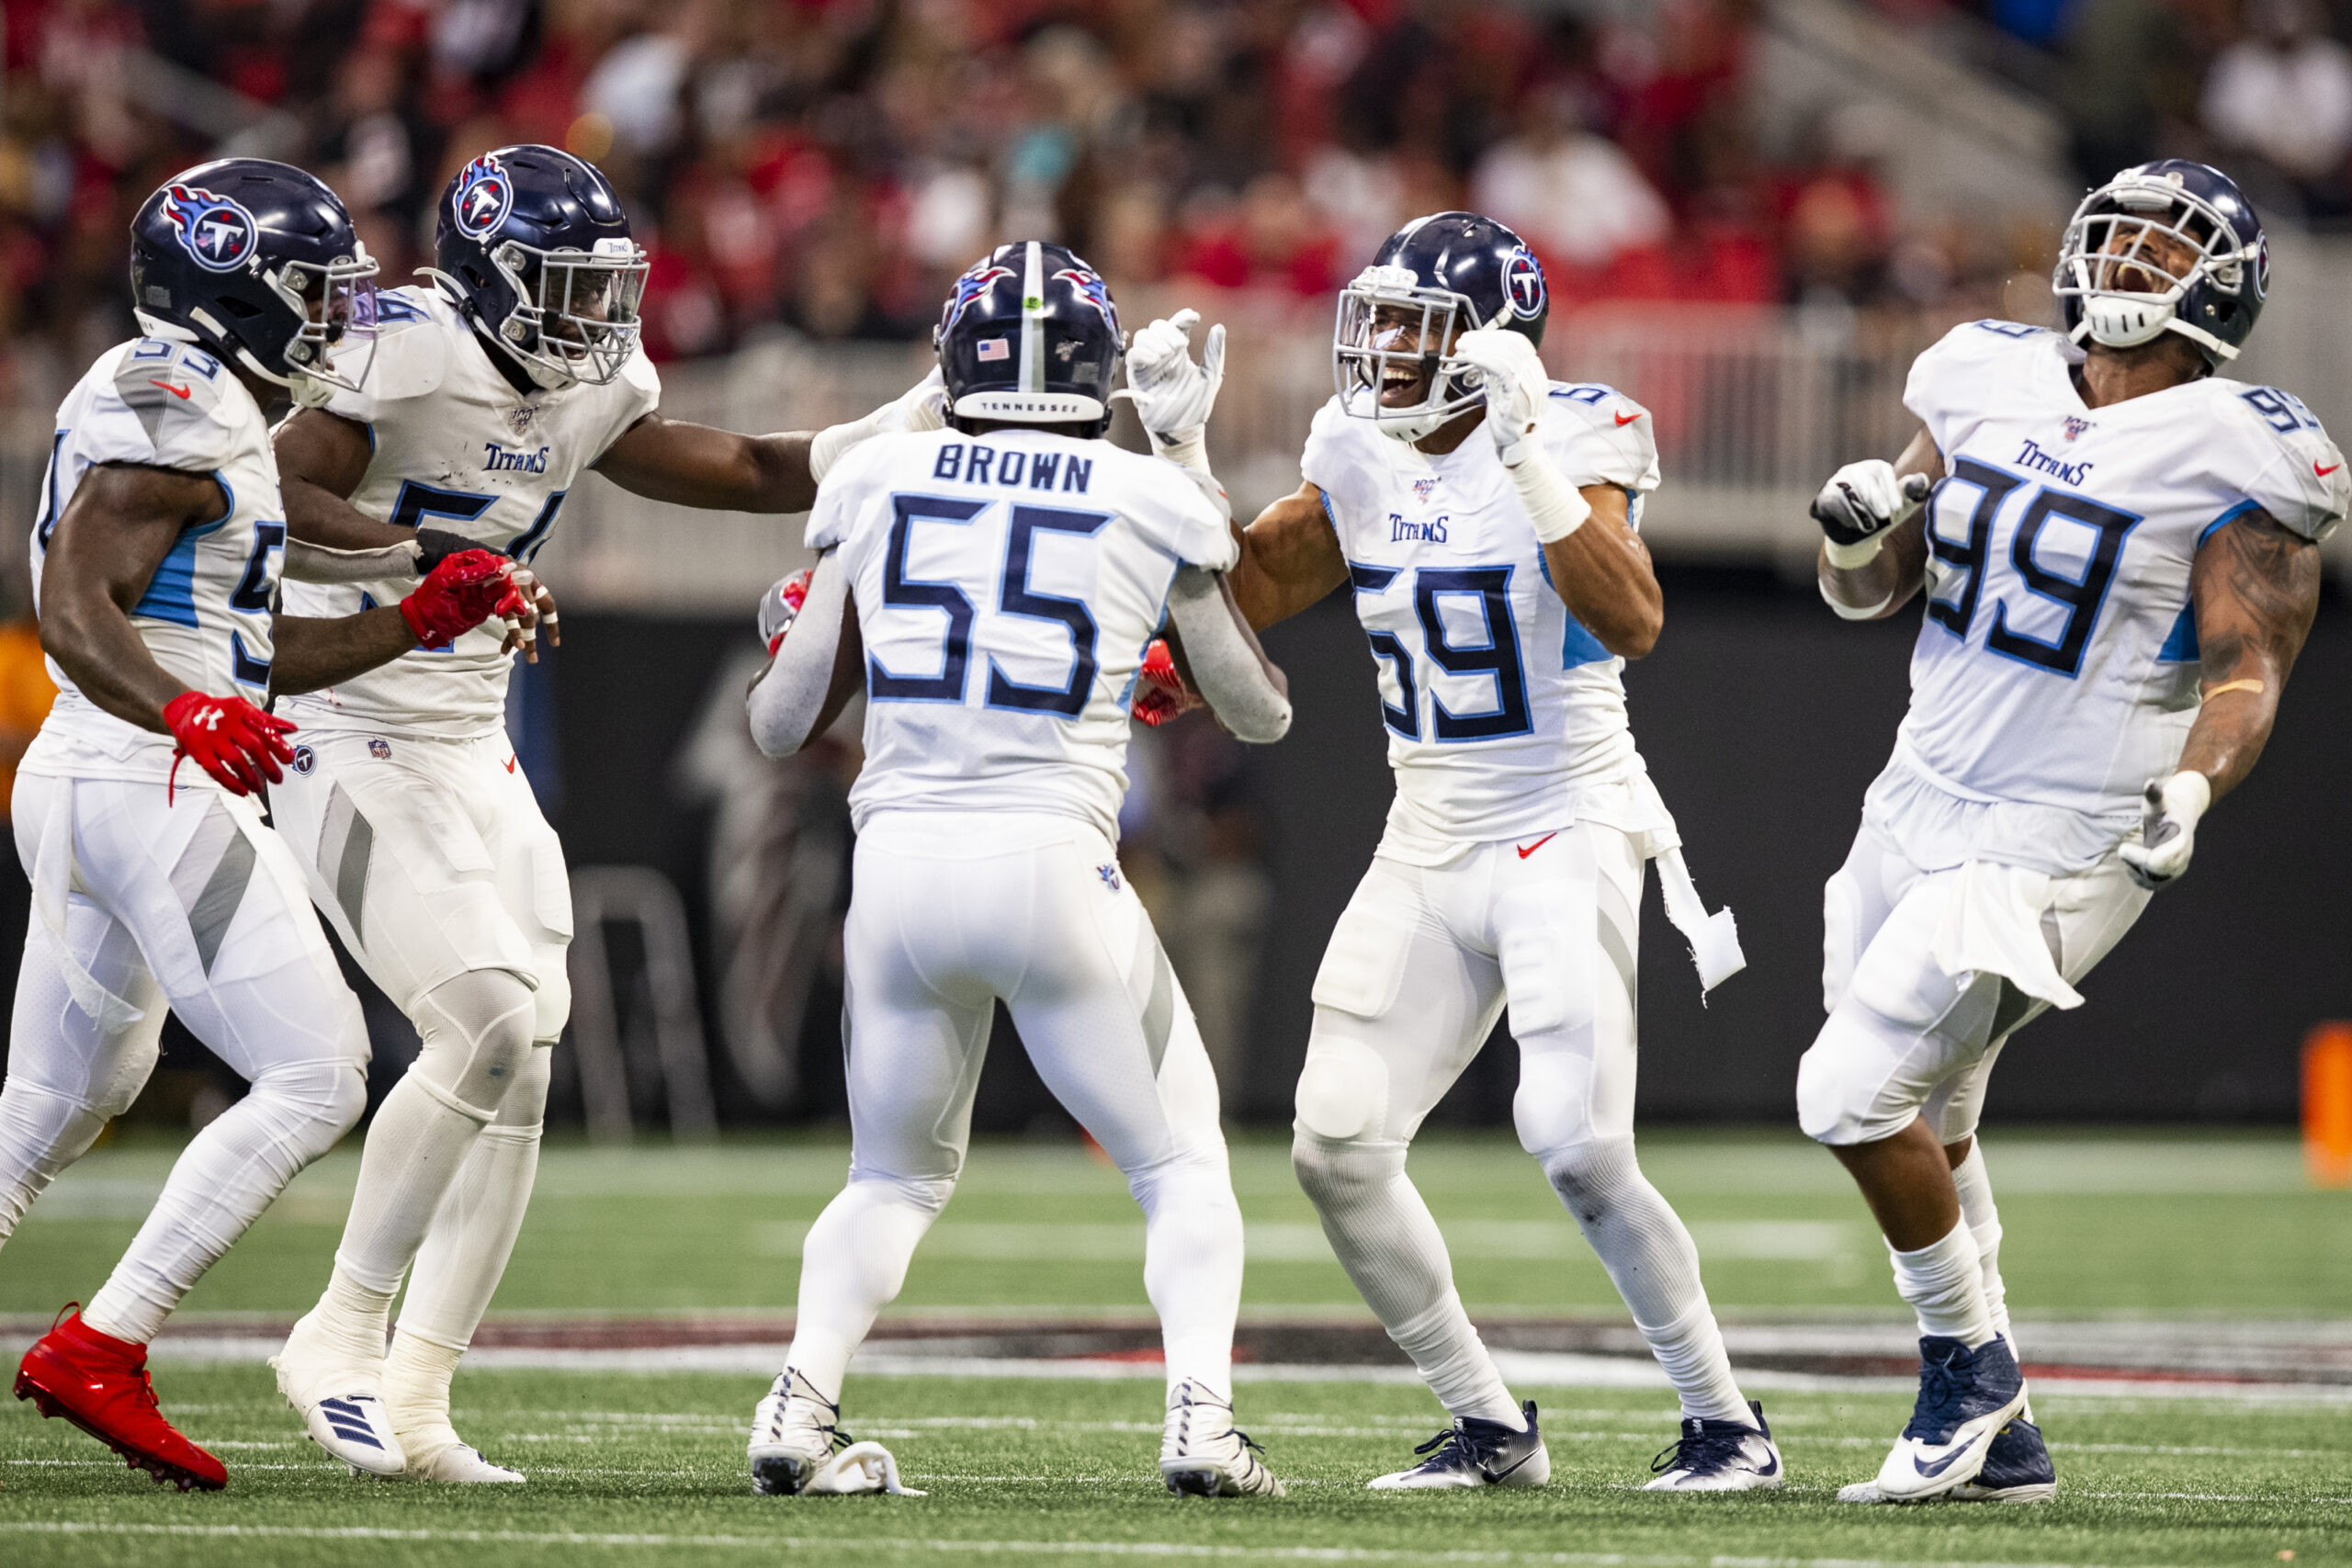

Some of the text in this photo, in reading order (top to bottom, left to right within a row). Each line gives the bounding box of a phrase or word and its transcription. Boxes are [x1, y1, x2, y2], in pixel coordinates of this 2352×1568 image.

[981, 402, 1080, 413] TENNESSEE
[481, 442, 550, 474] TITANS
[932, 443, 1093, 495] BROWN
[2012, 438, 2094, 487] TITANS
[1388, 513, 1449, 544] TITANS
[1925, 455, 2145, 681] 99
[867, 491, 1119, 722] 55
[1347, 558, 1535, 744] 59
